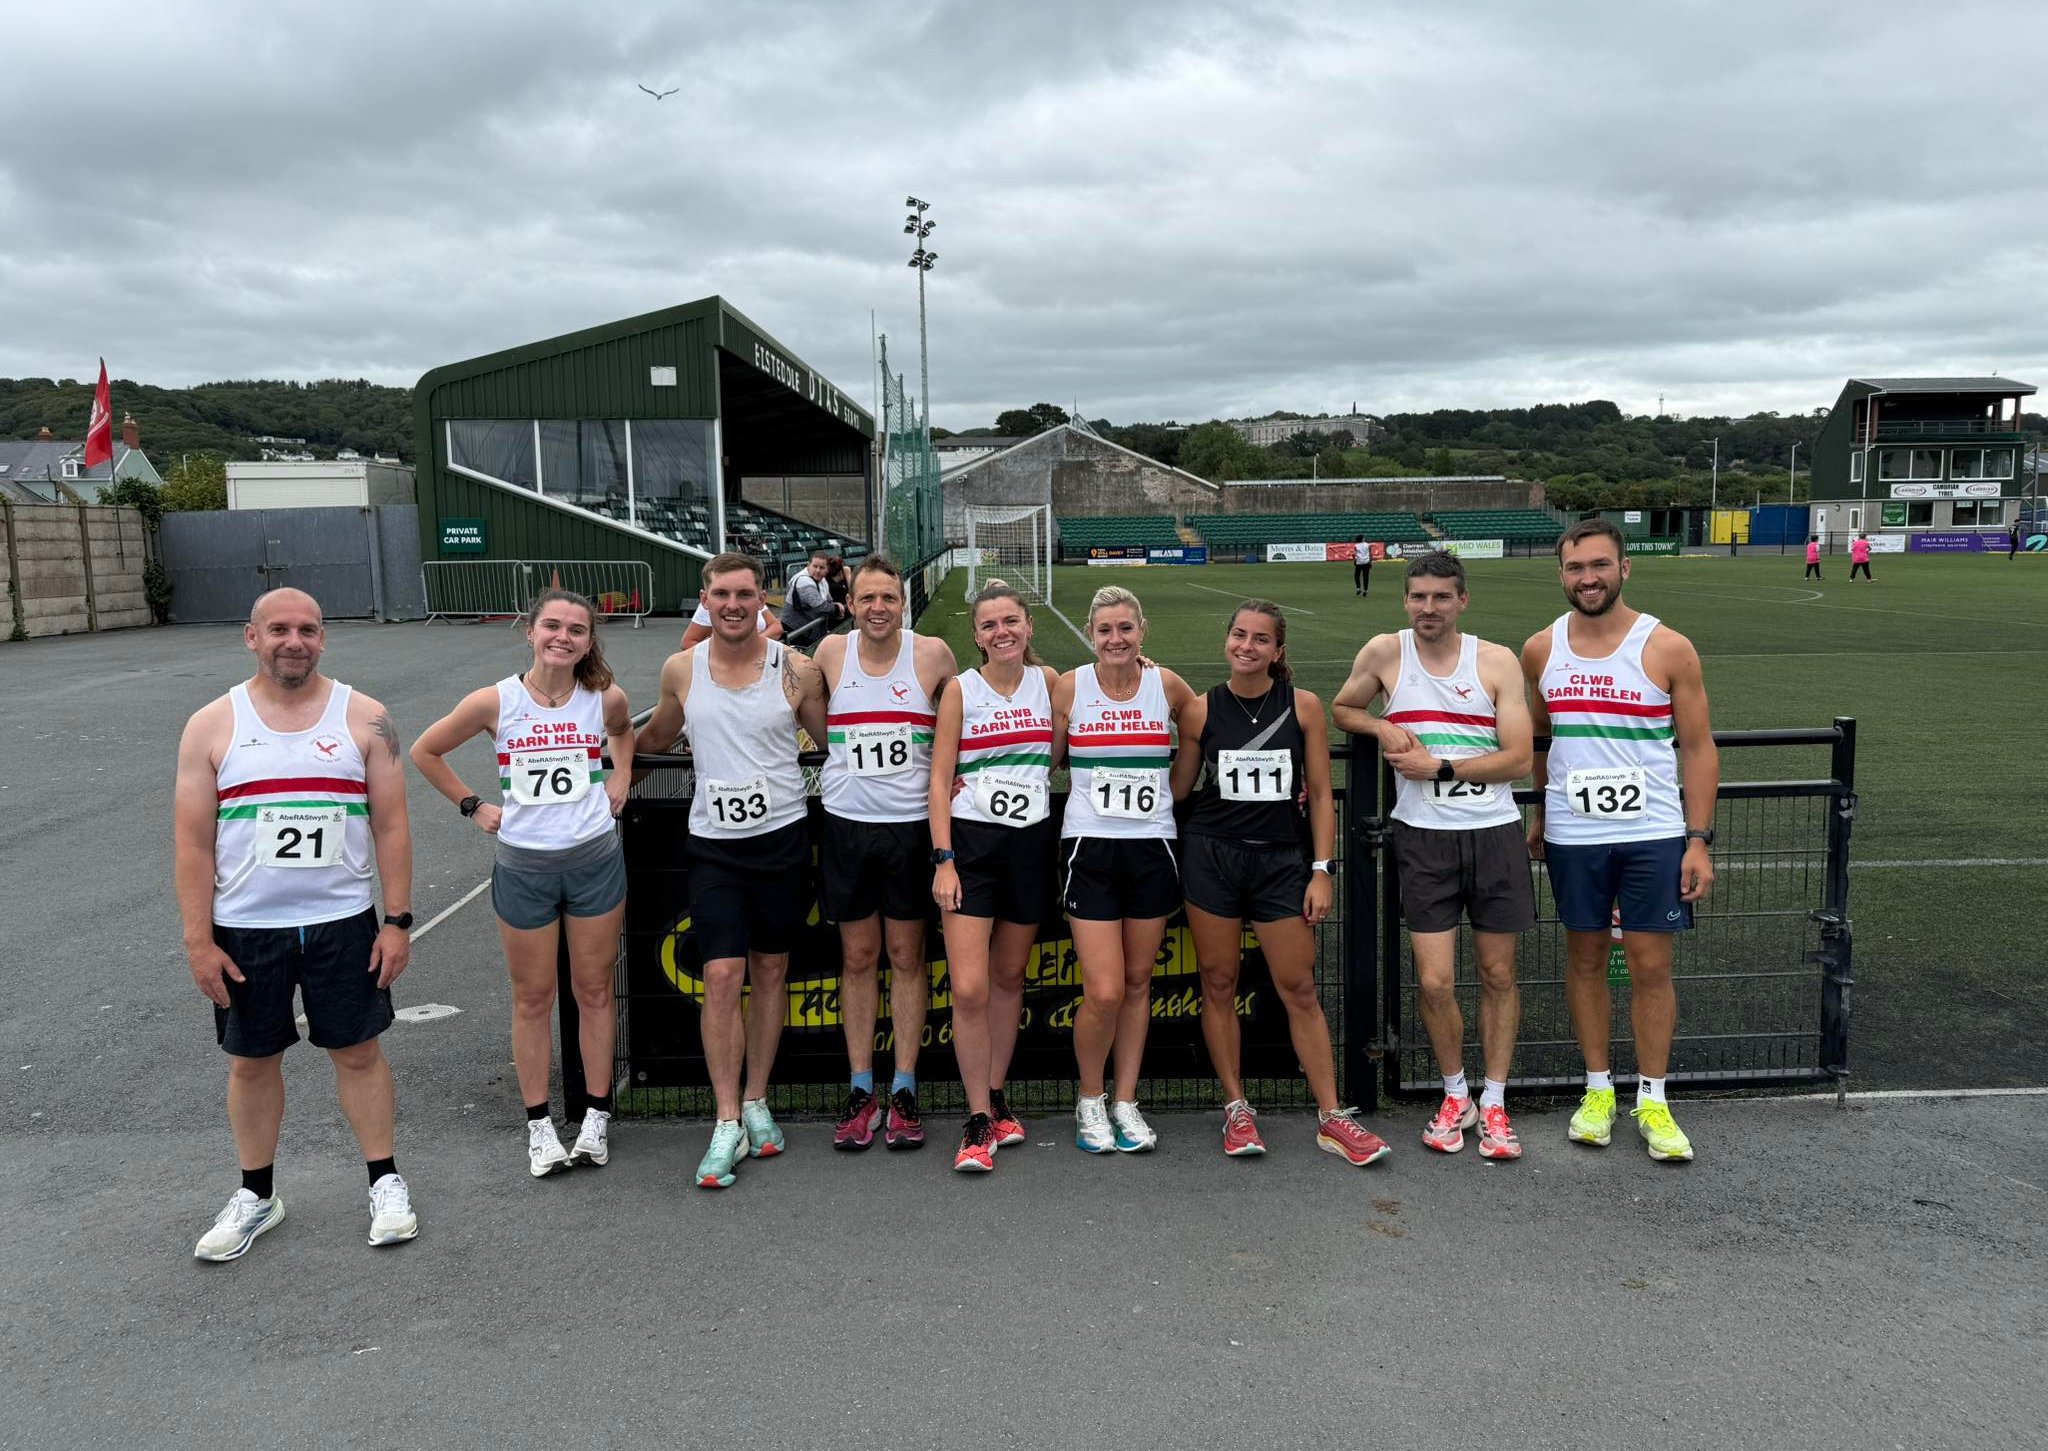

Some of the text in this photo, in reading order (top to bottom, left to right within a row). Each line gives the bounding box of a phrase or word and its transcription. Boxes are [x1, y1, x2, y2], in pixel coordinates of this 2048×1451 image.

[755, 342, 800, 393] EISTEDDLE
[446, 527, 478, 535] PRIVATE
[443, 536, 482, 544] CAR PARK
[1626, 542, 1640, 551] LOVE
[1641, 542, 1654, 551] THIS
[1570, 674, 1614, 686] CLWB
[1547, 687, 1642, 702] SARN HELEN
[993, 708, 1032, 720] CLWB
[1101, 710, 1142, 721] CLWB
[532, 722, 578, 734] CLWB
[971, 717, 1052, 735] SARN HELEN
[1078, 721, 1164, 733] SARN HELEN
[506, 733, 600, 750] SARN HELEN
[852, 740, 908, 770] 118
[527, 767, 573, 797] 76
[1225, 767, 1282, 793] 111
[990, 790, 1030, 822] 62
[1097, 783, 1155, 813] 116
[1575, 784, 1642, 814] 132
[712, 793, 768, 823] 133
[278, 813, 329, 822] AbeRAStwyth
[275, 827, 324, 859] 21
